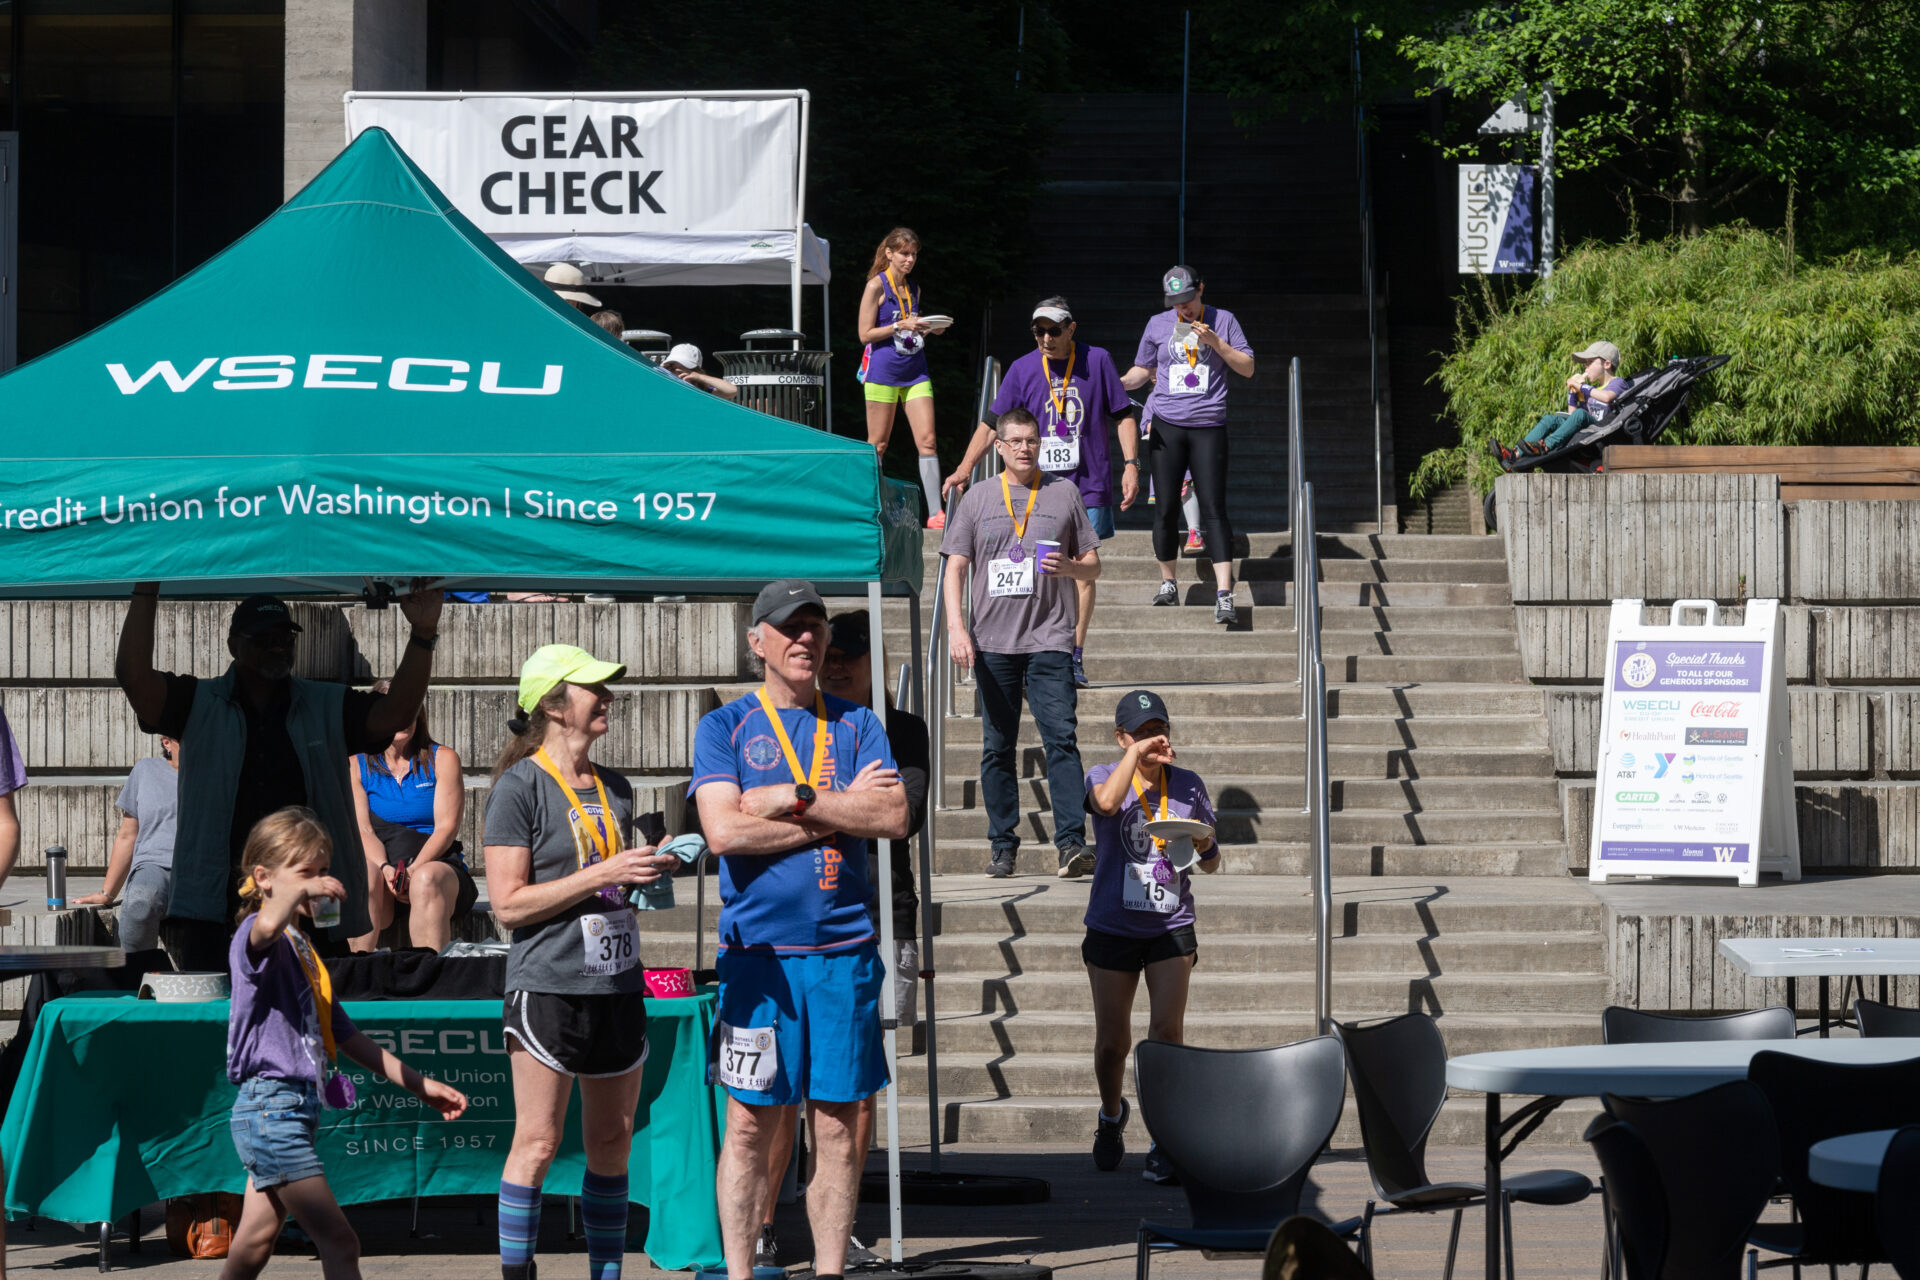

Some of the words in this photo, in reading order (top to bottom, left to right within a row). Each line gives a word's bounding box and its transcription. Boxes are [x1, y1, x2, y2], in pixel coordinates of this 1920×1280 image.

[501, 114, 644, 159] GEAR
[480, 170, 667, 215] CHECK
[1468, 170, 1488, 267] HUSKIES
[105, 354, 564, 395] WSECU
[778, 375, 819, 384] COMPOST
[1045, 448, 1071, 463] 183
[0, 496, 86, 529] redit
[100, 492, 203, 525] Union
[214, 485, 266, 518] for
[277, 483, 492, 525] Washington
[524, 489, 618, 521] Since
[632, 492, 716, 521] 1957
[997, 571, 1024, 588] 247
[1665, 652, 1707, 668] Special
[1708, 652, 1746, 665] Thanks
[1704, 678, 1749, 686] SPONSORS!
[1716, 670, 1733, 678] OUR
[1623, 700, 1681, 710] WSECU
[1617, 770, 1637, 779] AT&T
[1618, 793, 1656, 802] CARTER
[819, 849, 842, 890] Bay
[1143, 881, 1165, 901] 15
[600, 932, 632, 961] 378
[361, 1029, 508, 1055] SECU
[726, 1047, 761, 1075] 377
[444, 1069, 506, 1084] Union
[346, 1136, 424, 1156] SINCE
[440, 1135, 496, 1149] 1957
